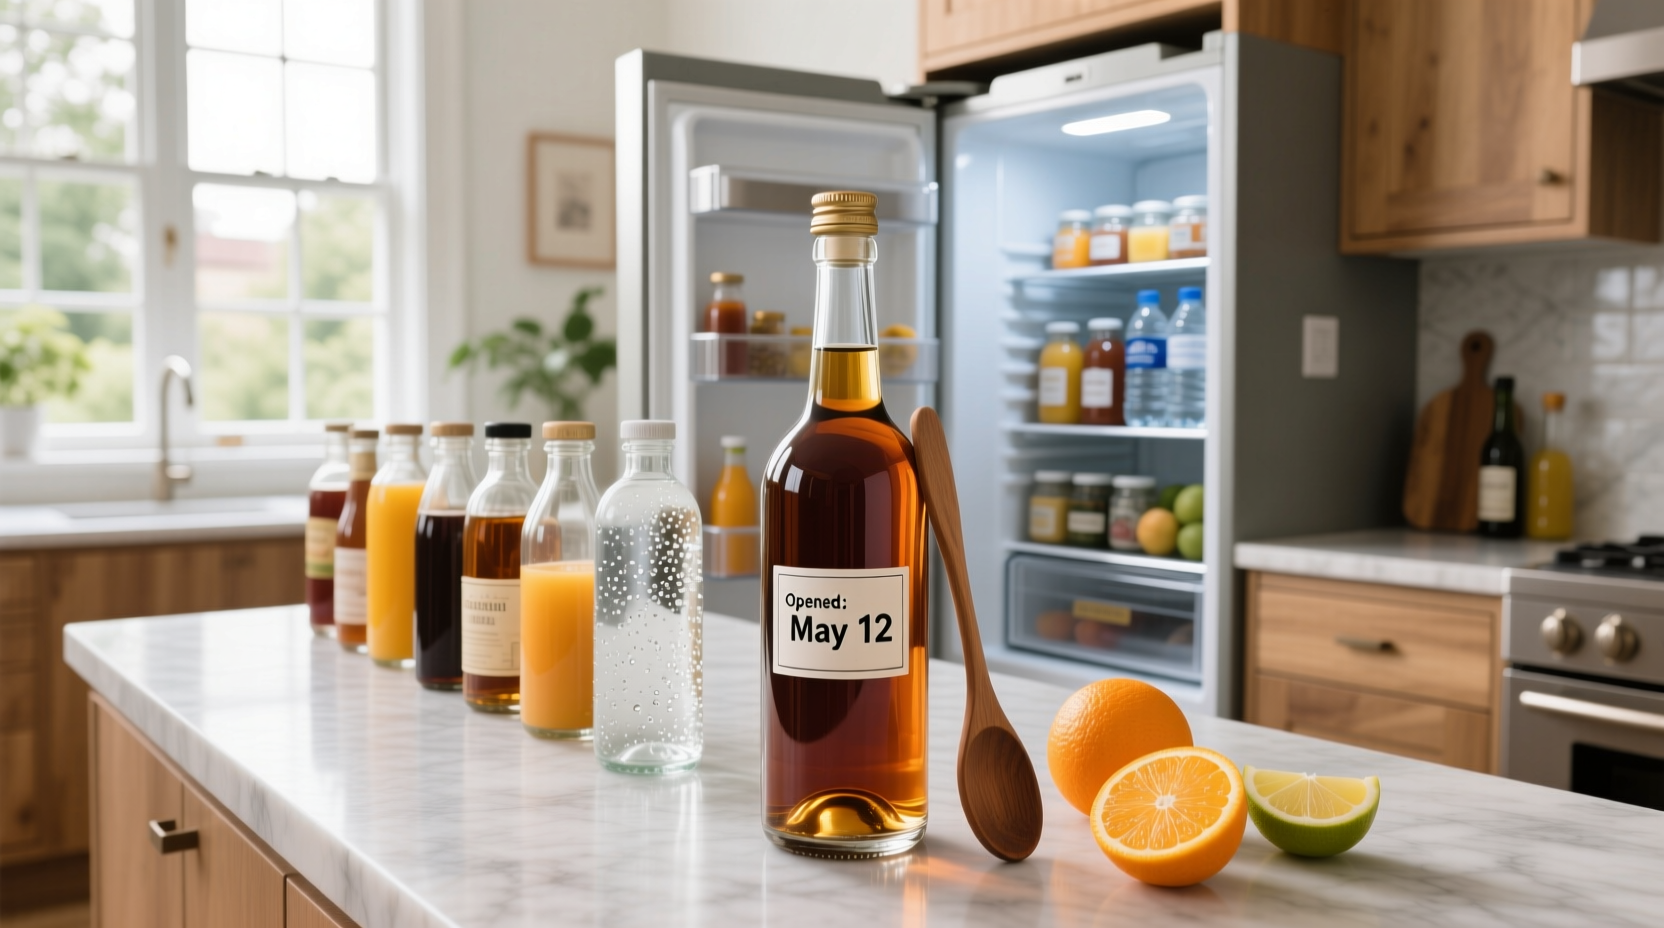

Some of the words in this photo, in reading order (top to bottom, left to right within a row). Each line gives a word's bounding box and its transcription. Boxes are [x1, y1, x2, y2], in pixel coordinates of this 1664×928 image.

[785, 593, 847, 612] Opened:
[790, 614, 849, 651] May
[858, 613, 893, 644] 12
